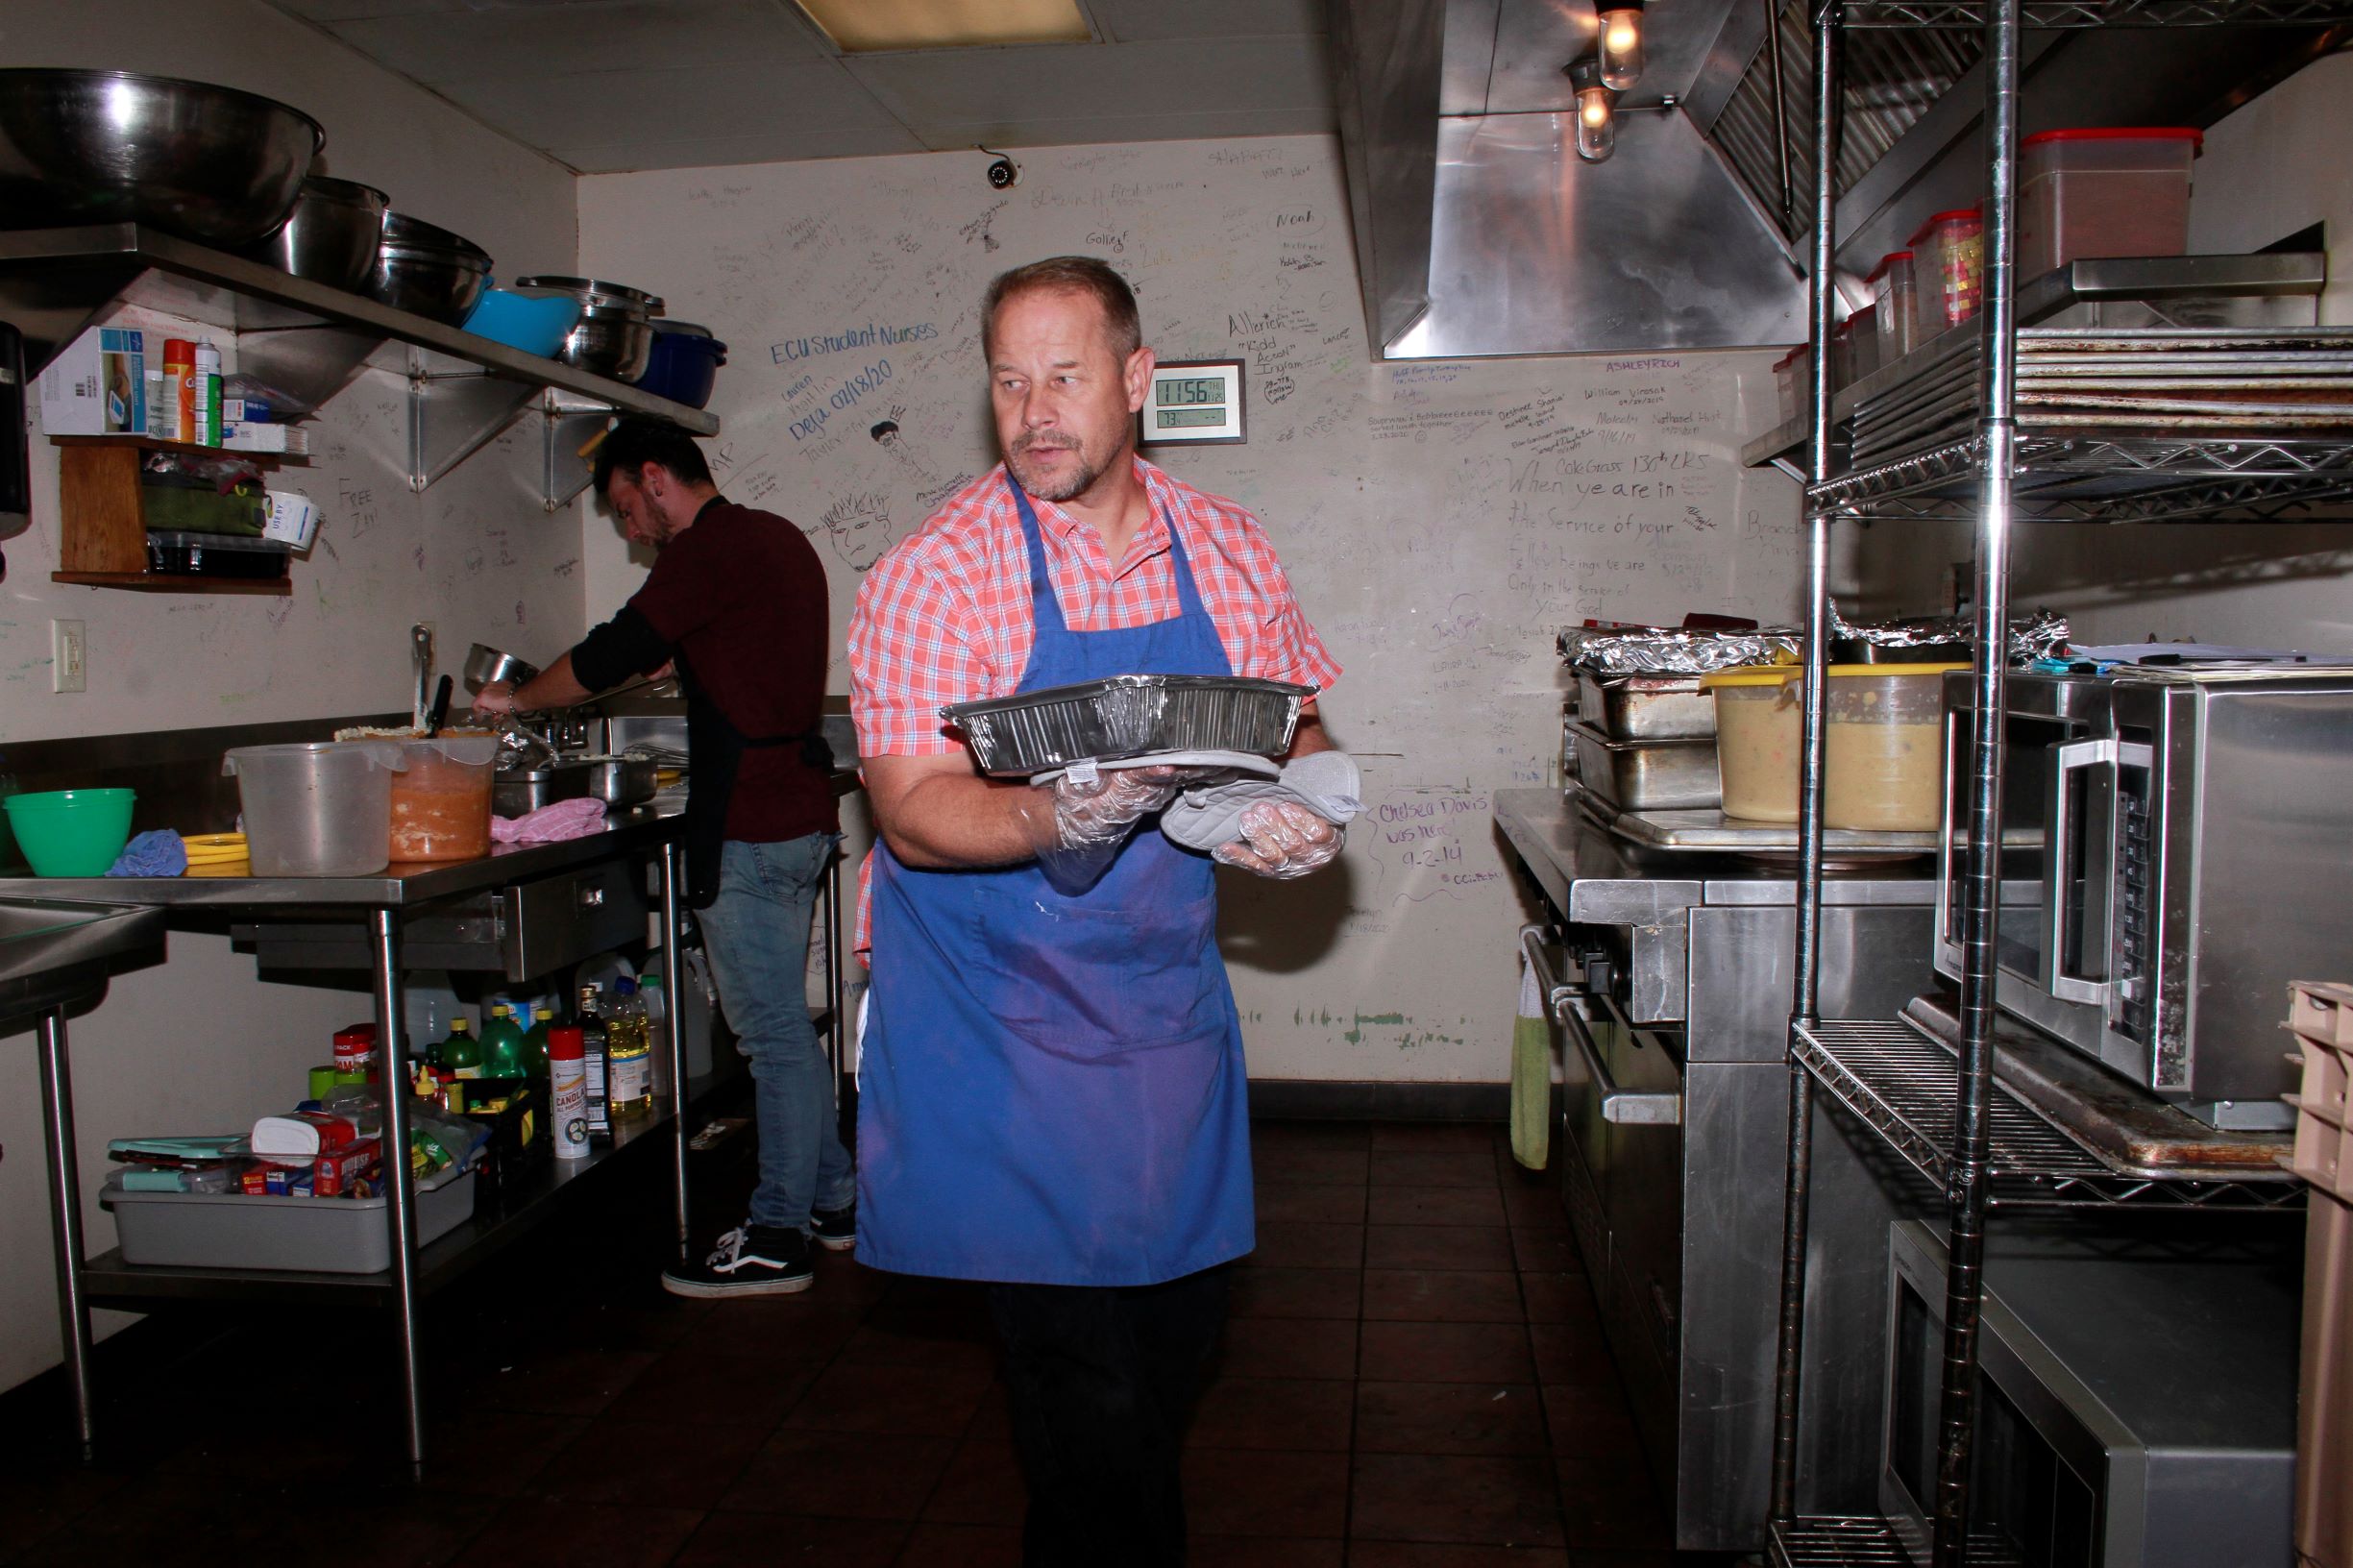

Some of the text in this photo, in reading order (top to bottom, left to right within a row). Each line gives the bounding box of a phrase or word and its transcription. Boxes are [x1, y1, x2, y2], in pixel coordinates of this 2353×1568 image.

[1276, 209, 1315, 230] Noah
[878, 322, 940, 347] Nurses
[1583, 388, 1621, 401] William
[789, 406, 831, 441] Deja
[1504, 457, 1565, 496] When
[1576, 481, 1606, 512] ye
[1611, 484, 1652, 499] are
[1657, 480, 1676, 498] in
[1613, 512, 1635, 534] of
[1638, 522, 1676, 544] your
[1624, 560, 1646, 572] are
[1542, 579, 1555, 595] in
[1379, 795, 1489, 823] Chelsea Davis
[555, 1088, 584, 1107] CANOLA
